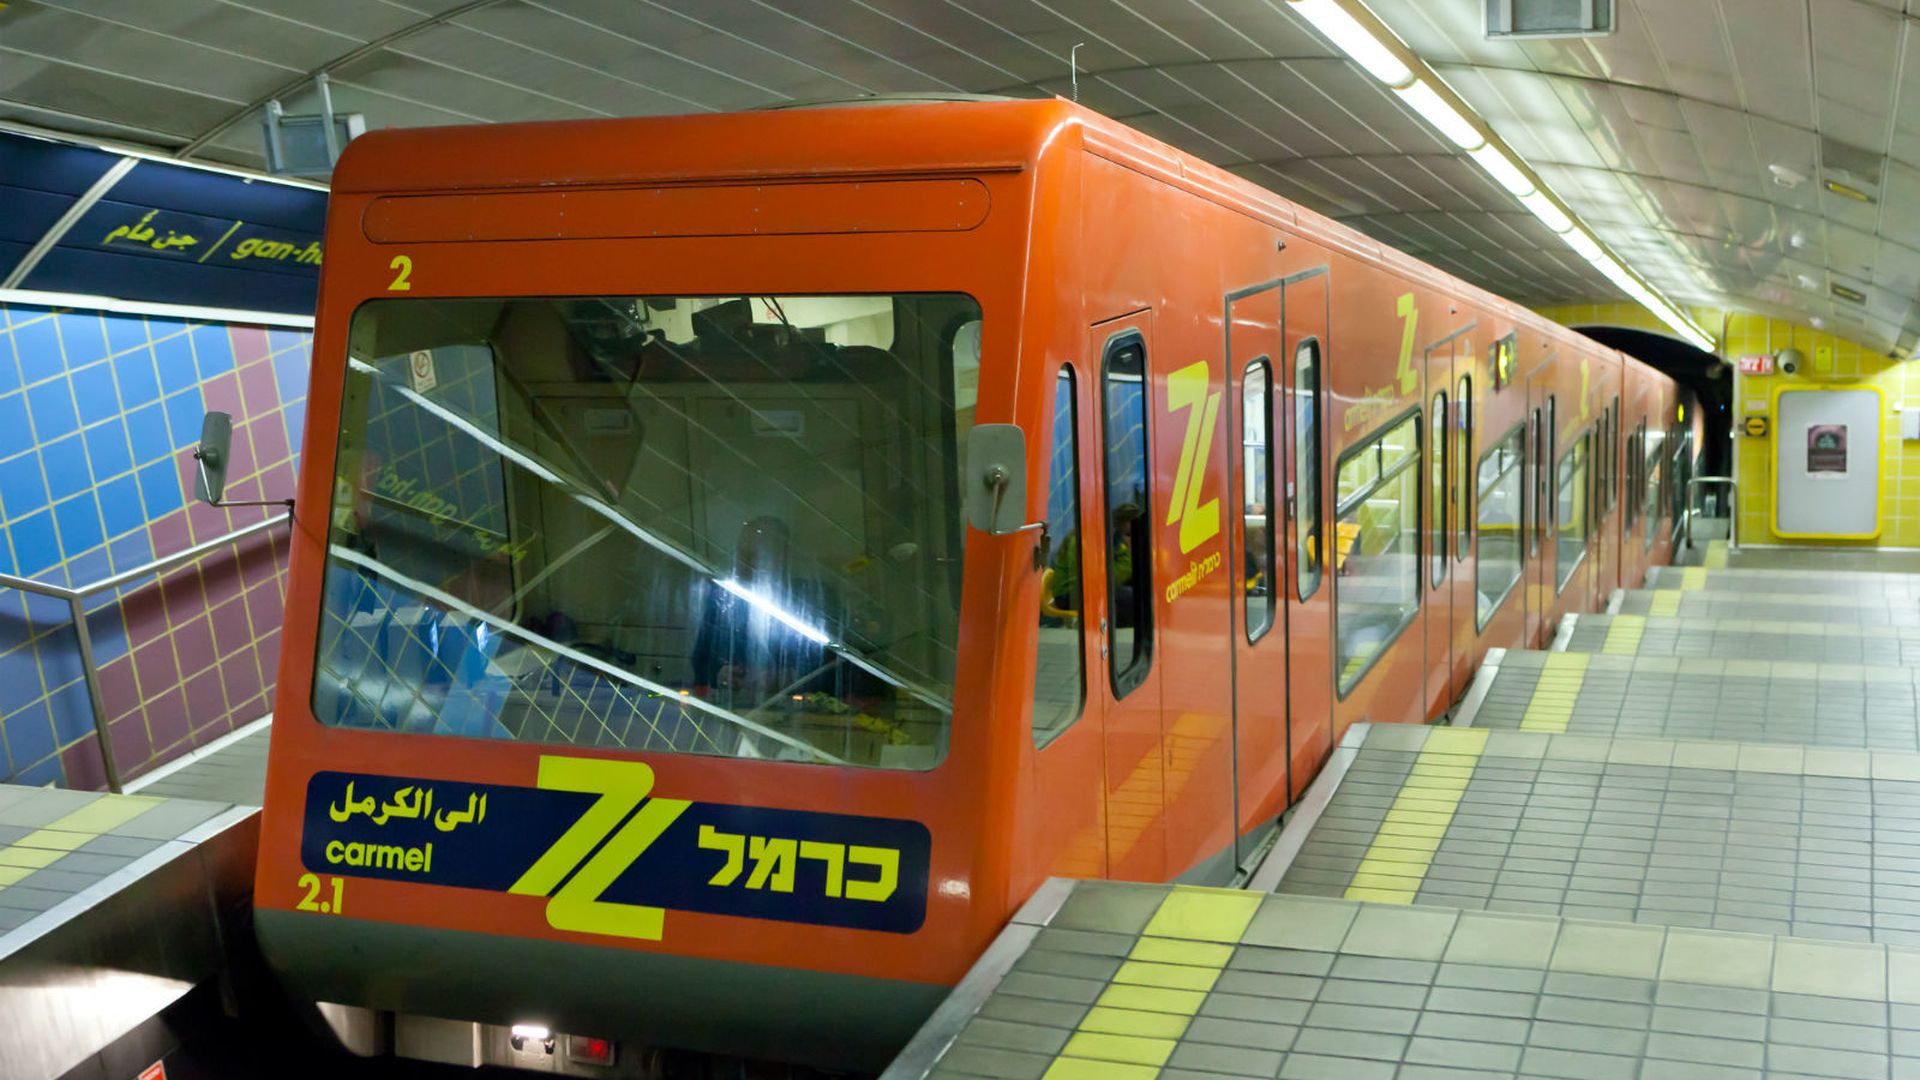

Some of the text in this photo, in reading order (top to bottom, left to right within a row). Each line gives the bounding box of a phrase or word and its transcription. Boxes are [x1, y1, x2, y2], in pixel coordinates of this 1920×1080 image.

[387, 255, 412, 290] 2
[329, 780, 433, 826] الكرمل
[325, 840, 433, 873] carmel
[698, 824, 900, 903] כרמל
[296, 873, 345, 915] 2.1
